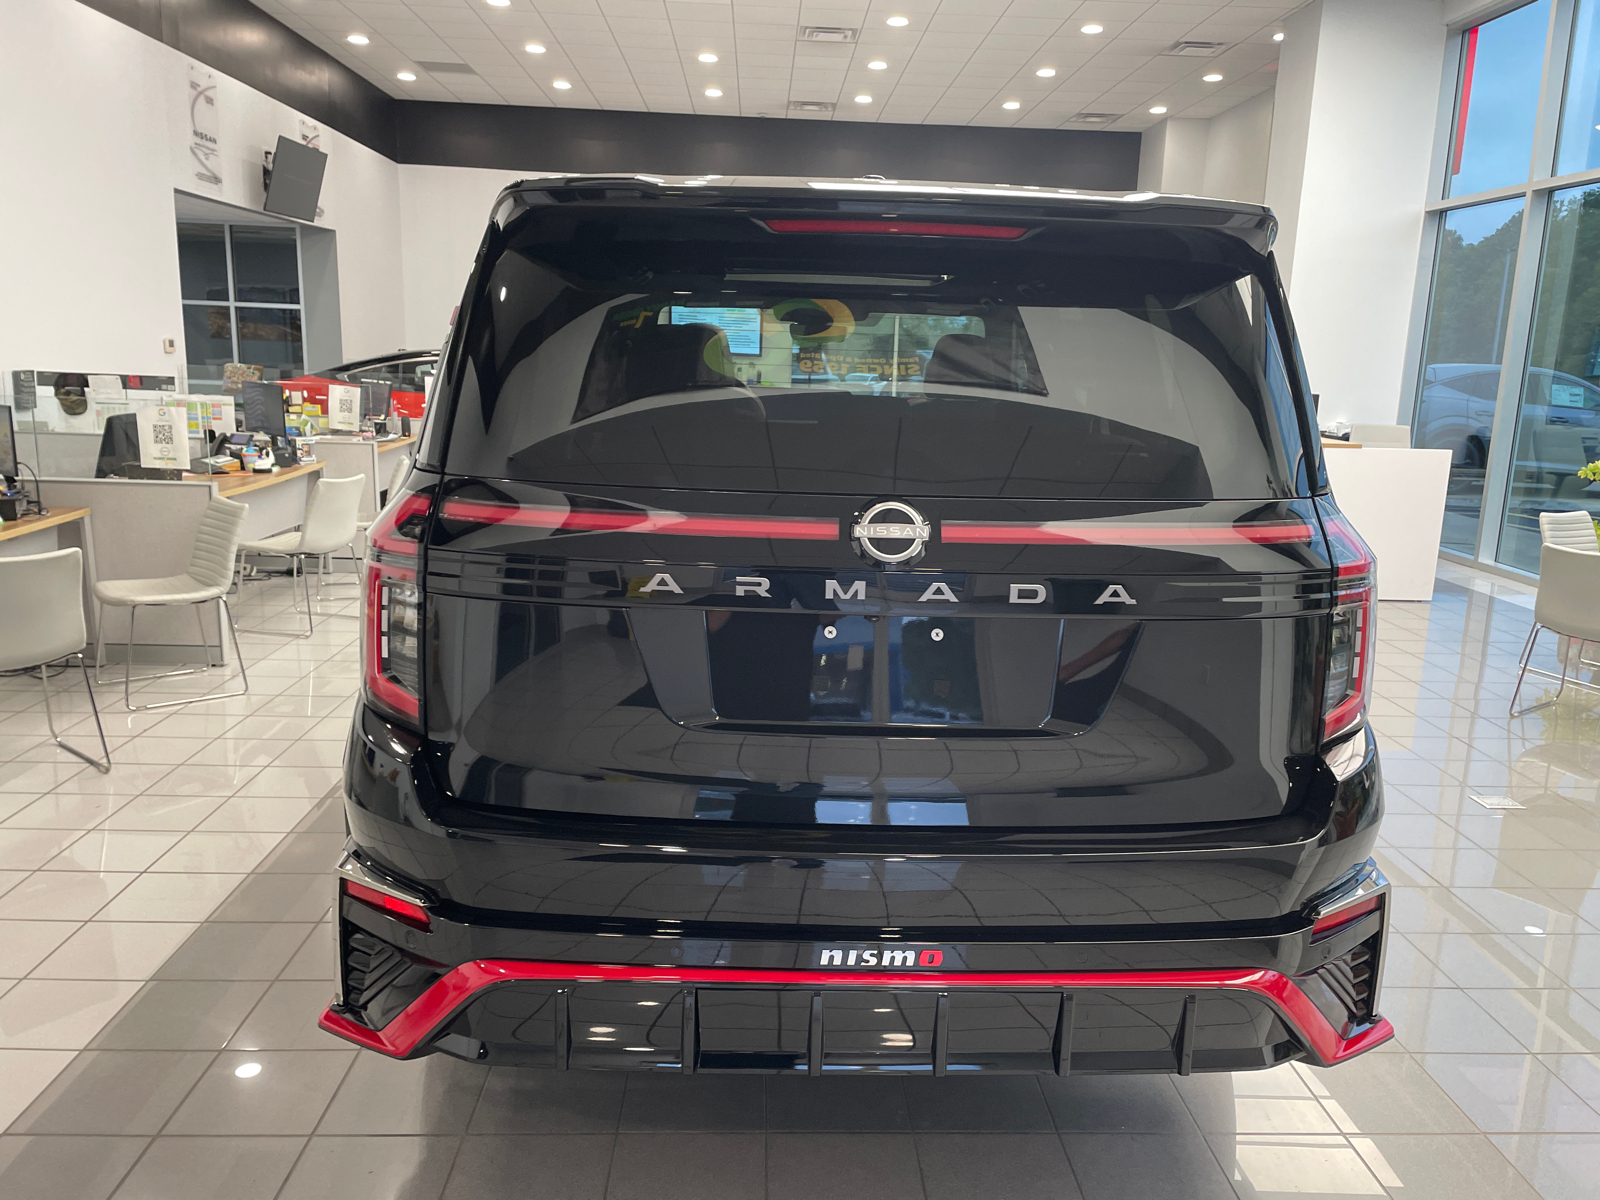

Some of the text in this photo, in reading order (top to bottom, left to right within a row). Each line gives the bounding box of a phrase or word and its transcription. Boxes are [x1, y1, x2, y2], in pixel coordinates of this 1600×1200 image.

[193, 129, 217, 145] NISSAN
[856, 526, 928, 538] NISSAN
[639, 573, 1138, 605] ARMADA
[819, 949, 944, 967] nismo
